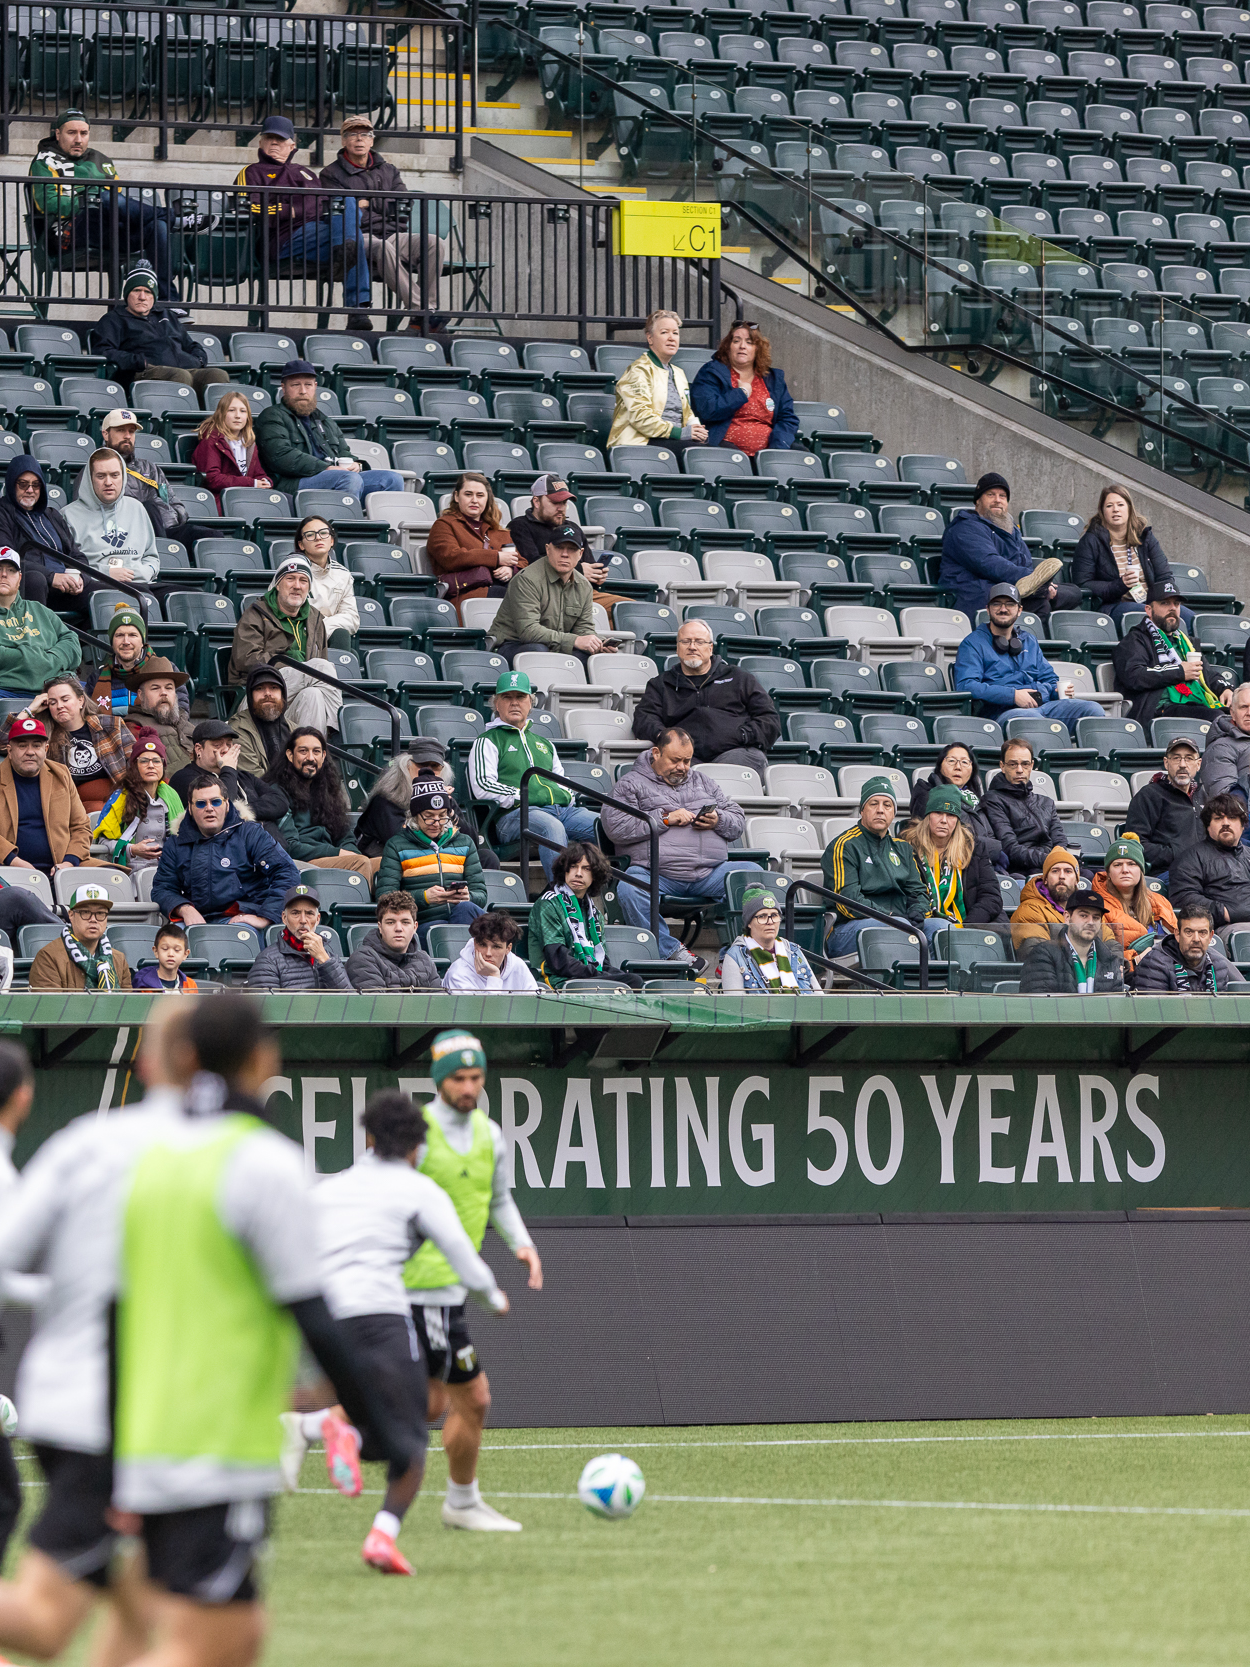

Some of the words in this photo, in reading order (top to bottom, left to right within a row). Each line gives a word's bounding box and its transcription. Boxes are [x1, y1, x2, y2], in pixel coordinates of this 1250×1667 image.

[682, 205, 707, 214] SECTION
[689, 225, 715, 252] C1
[807, 1075, 905, 1186] 50
[920, 1073, 1167, 1184] YEARS
